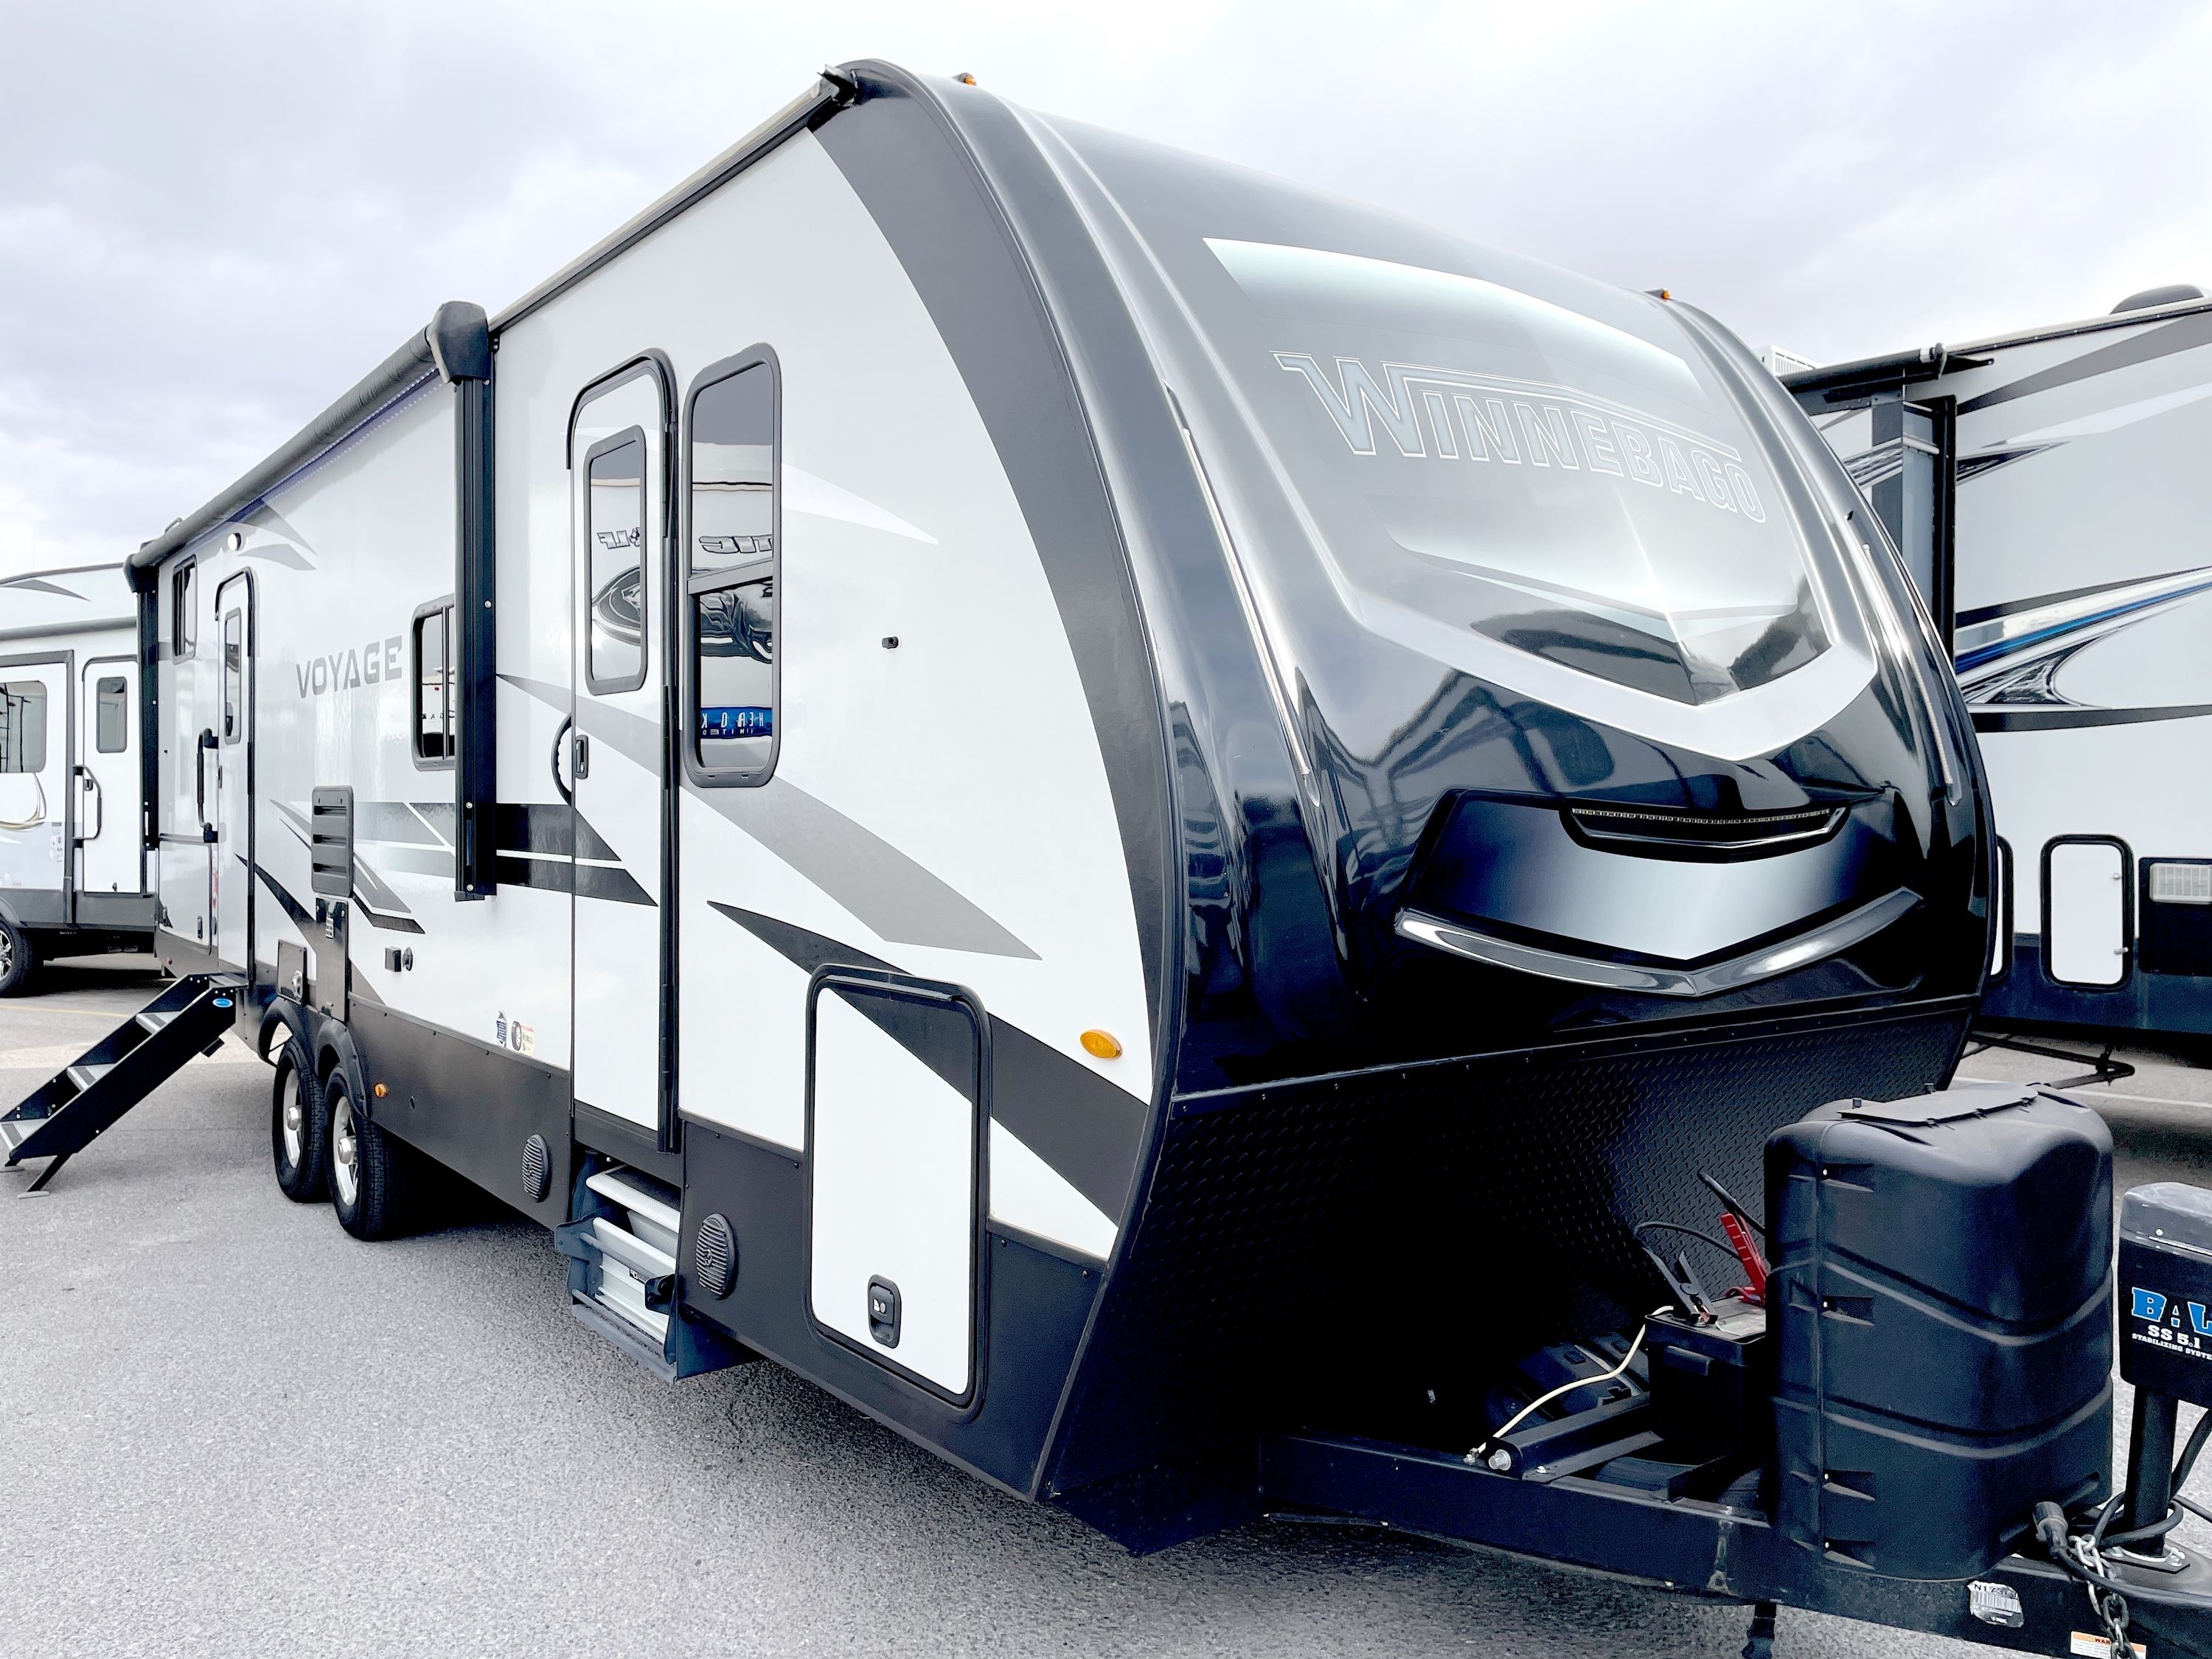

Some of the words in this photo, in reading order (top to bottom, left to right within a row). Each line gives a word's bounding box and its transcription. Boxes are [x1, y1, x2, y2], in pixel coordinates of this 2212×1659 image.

[1269, 350, 1766, 524] WINNEBAGO
[296, 635, 403, 699] VOYAGE
[2132, 1332, 2183, 1352] STABILIZING
[2147, 1324, 2173, 1341] SS
[2177, 1332, 2201, 1349] 5.1
